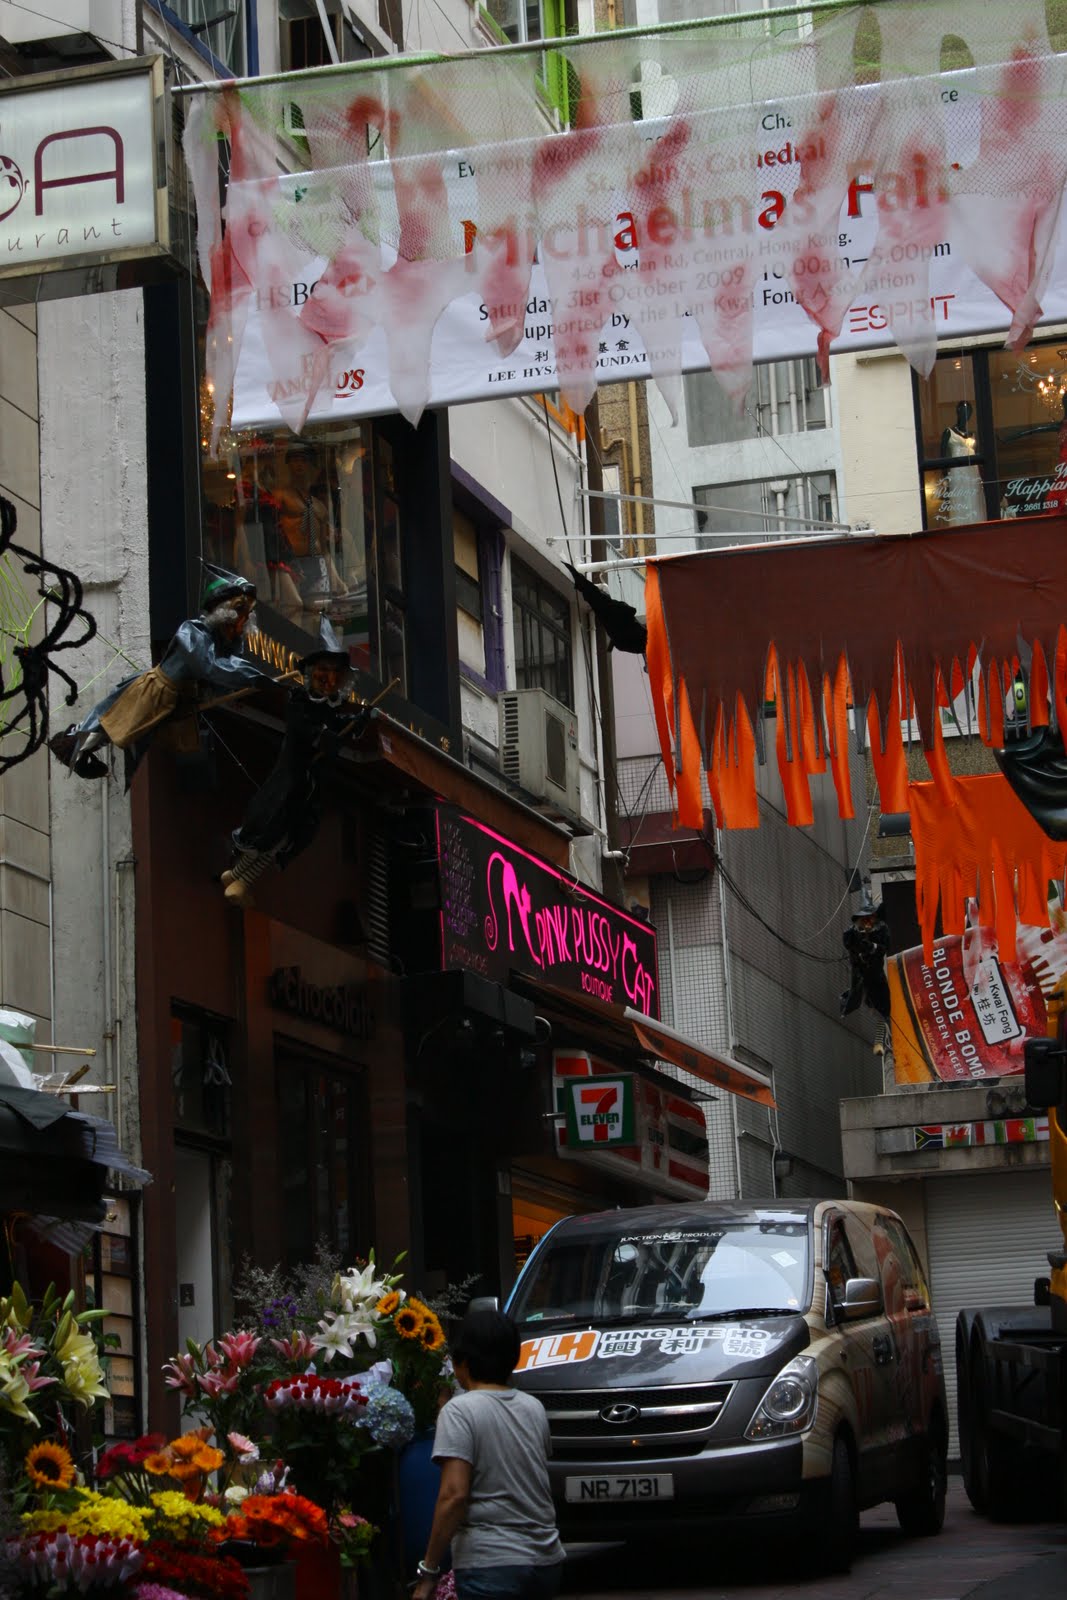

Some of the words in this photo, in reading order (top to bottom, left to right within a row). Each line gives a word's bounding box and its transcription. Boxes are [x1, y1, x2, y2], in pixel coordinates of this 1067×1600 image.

[460, 186, 818, 271] Michaelmas
[608, 279, 688, 302] October
[696, 263, 745, 290] 2009
[524, 318, 605, 341] upported
[612, 312, 632, 329] by
[850, 294, 956, 333] ESPRIT
[488, 370, 516, 383] LEE
[581, 349, 677, 370] FOUNDATION
[535, 905, 573, 971] PINK
[572, 906, 621, 980] PUSSY
[622, 931, 655, 1016] CAT
[581, 971, 614, 1003] BOUTIQUE
[932, 946, 964, 1025] BLONDE
[954, 1029, 987, 1079] BOMB
[989, 983, 1006, 1009] Kwai
[998, 1009, 1013, 1035] Fong
[929, 992, 950, 1040] GOLDEN
[945, 1043, 964, 1076] LAGER
[682, 1231, 724, 1239] PRODUCE
[605, 1330, 668, 1342] HING
[676, 1329, 723, 1338] LEE
[732, 1329, 768, 1339] HO
[580, 1480, 610, 1499] NR
[616, 1478, 659, 1498] 7131
